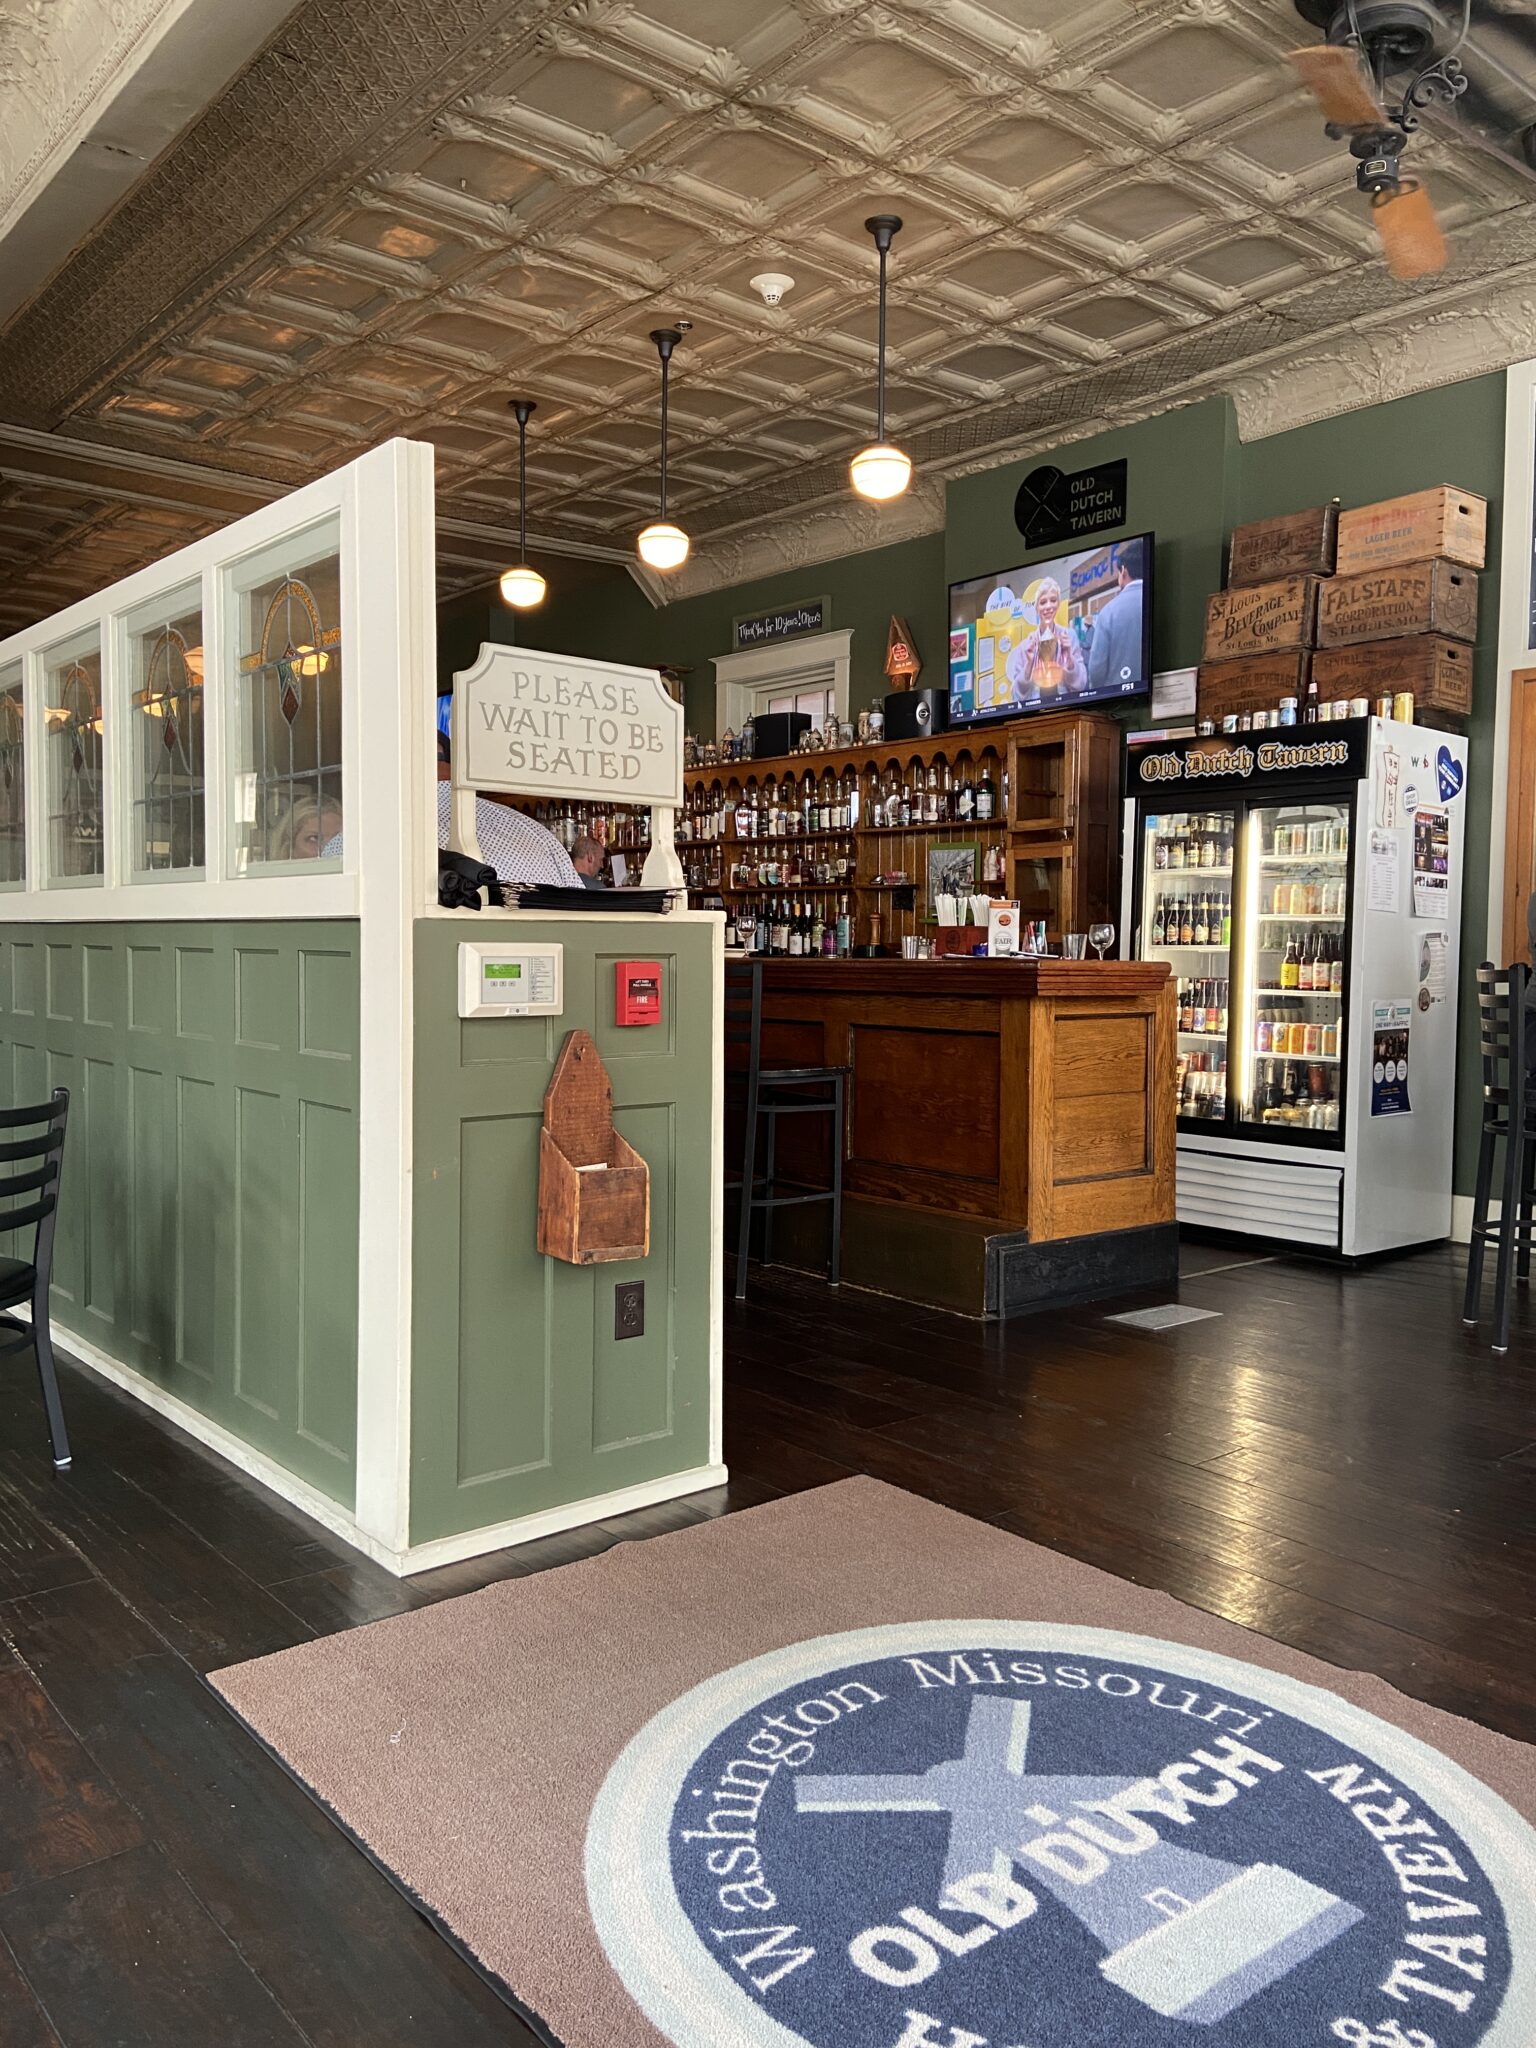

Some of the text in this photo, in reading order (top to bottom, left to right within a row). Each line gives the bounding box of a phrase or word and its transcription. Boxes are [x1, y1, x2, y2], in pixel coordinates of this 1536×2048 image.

[1070, 476, 1095, 494] OLD
[1070, 489, 1113, 513] DUTCH
[1070, 505, 1122, 531] TAVERN
[1326, 579, 1426, 617] FALSTAFF
[1335, 600, 1415, 624] CORPORATION
[775, 616, 783, 631] 10
[1219, 595, 1285, 644] BEVERAGE
[1252, 608, 1303, 637] COMPANY
[512, 671, 640, 715] PLEASE
[1121, 682, 1134, 691] FS1
[478, 701, 664, 753] WAIT TO BE
[505, 740, 642, 780] SEATED
[1140, 740, 1348, 782] Old Dutch Tavern
[636, 995, 649, 1004] FIRE
[681, 1652, 1275, 1995] Washington Missouri
[848, 1733, 1286, 1988] OLD DUTCH
[1304, 1762, 1488, 2013] TAVERN
